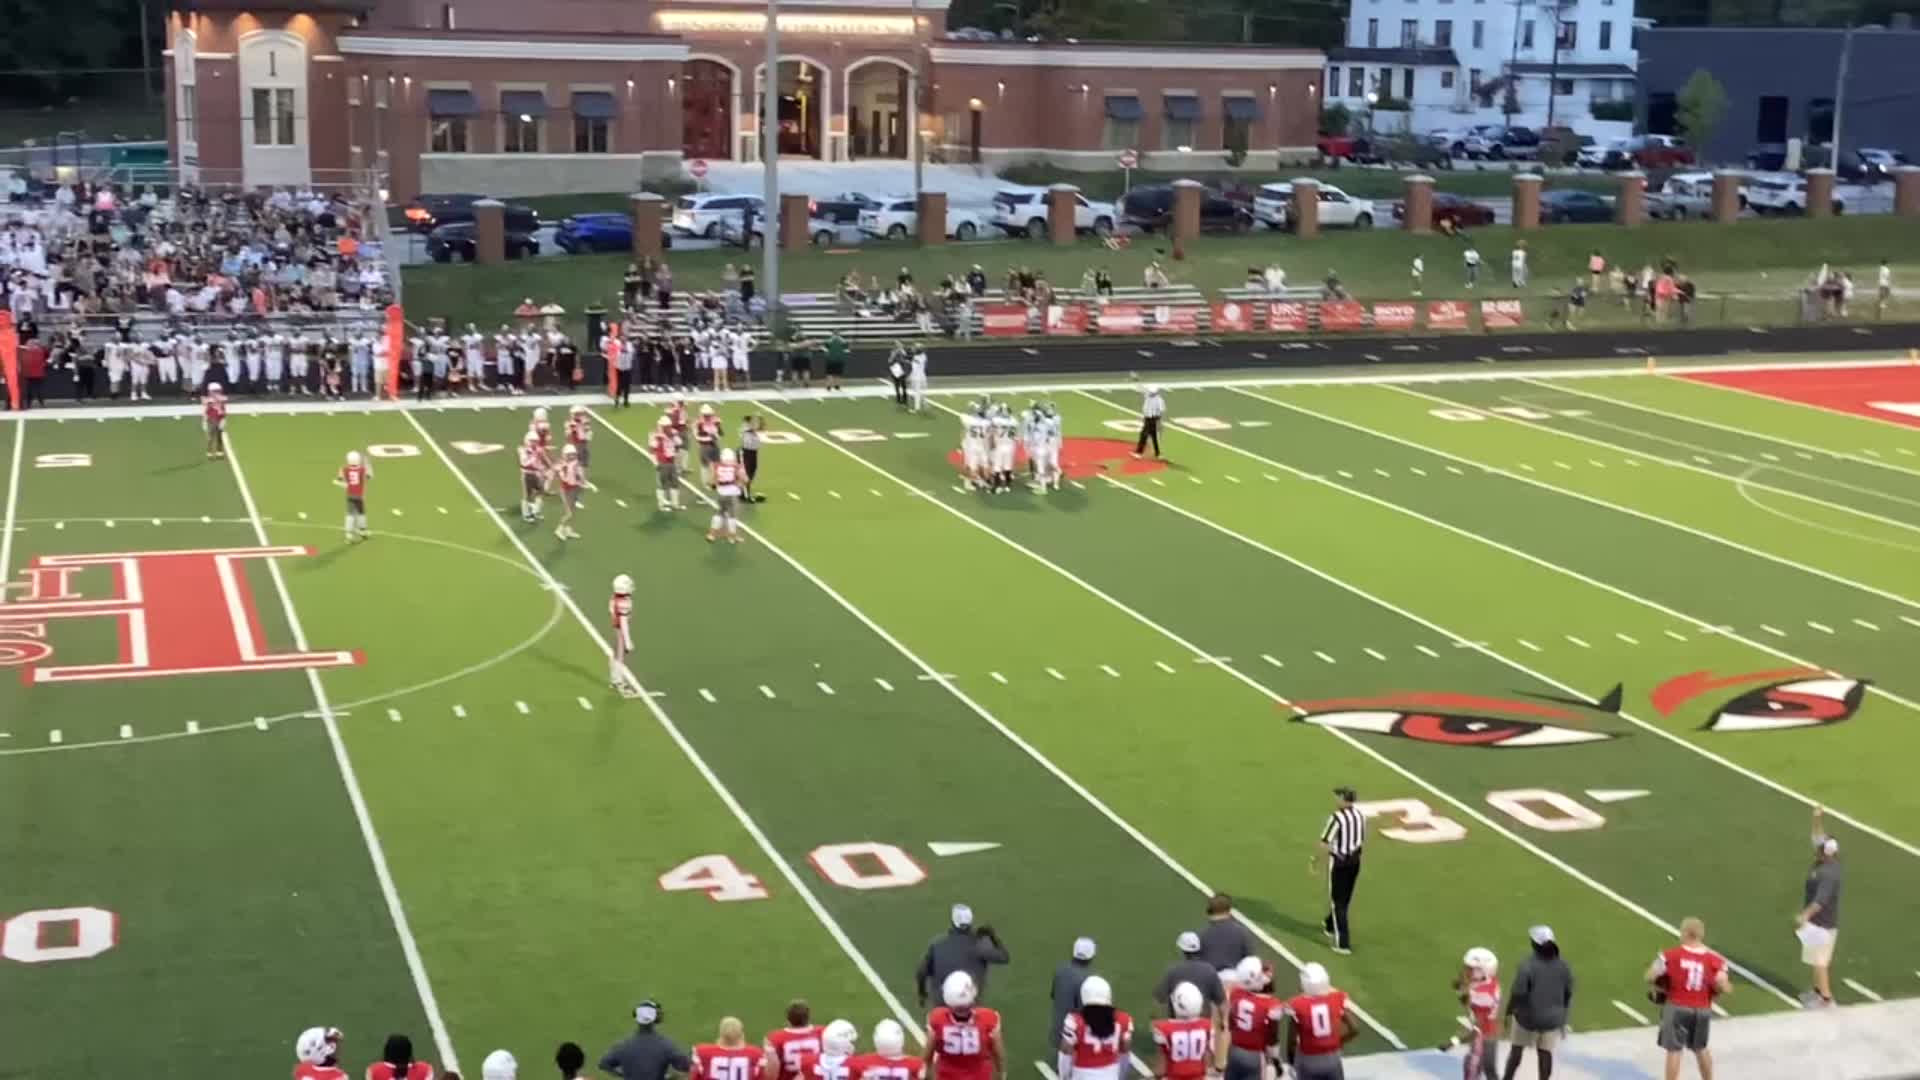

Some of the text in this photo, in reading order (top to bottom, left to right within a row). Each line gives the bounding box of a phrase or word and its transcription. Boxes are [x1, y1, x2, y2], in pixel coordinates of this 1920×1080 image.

[0, 905, 118, 964] 0
[1236, 998, 1256, 1032] 5
[1310, 1003, 1332, 1038] 0
[942, 1024, 982, 1055] 58
[1170, 1029, 1208, 1062] 80
[710, 1055, 749, 1080] 50
